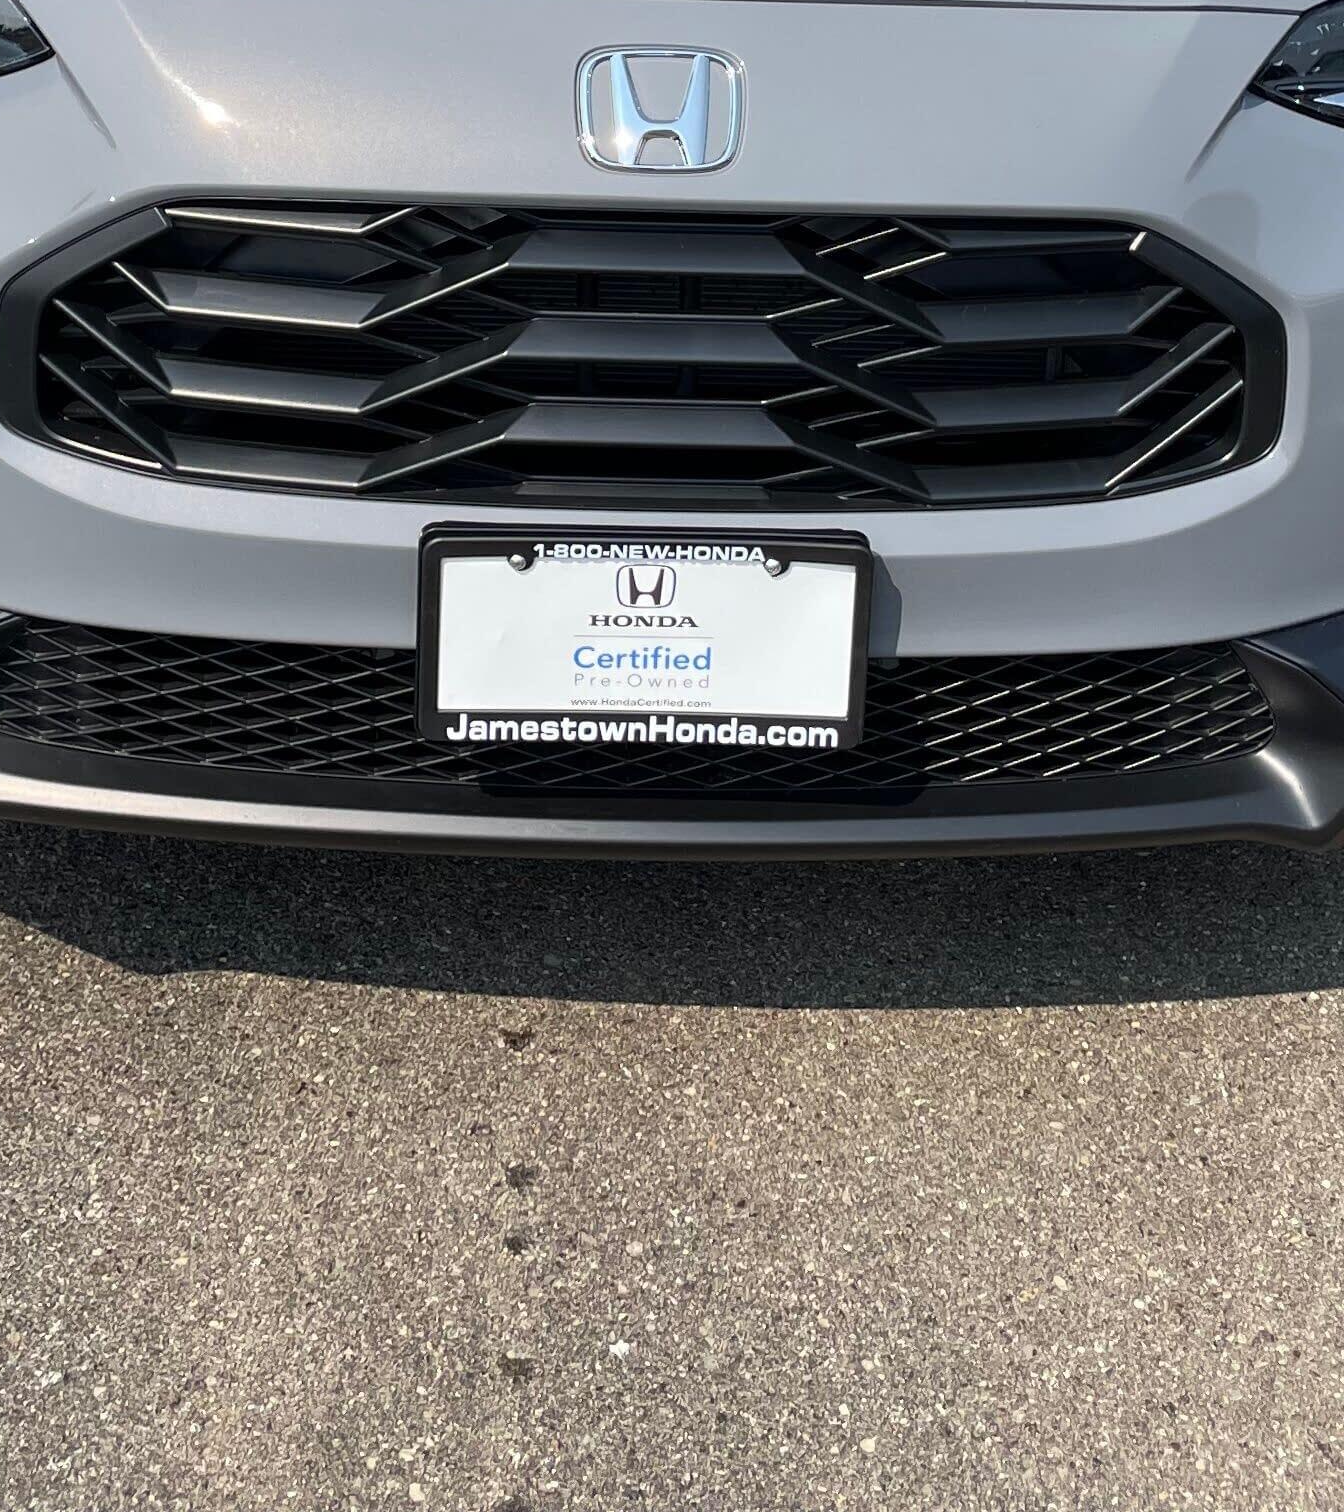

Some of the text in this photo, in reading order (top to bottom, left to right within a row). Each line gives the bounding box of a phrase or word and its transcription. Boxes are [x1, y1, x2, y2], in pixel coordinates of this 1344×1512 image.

[532, 543, 766, 562] 1-800-NEW-HONDA
[588, 615, 699, 628] HONDA
[573, 645, 712, 671] Certified
[573, 673, 710, 689] Pre-Owned
[570, 697, 712, 709] www.HondaCertified.com
[446, 713, 839, 749] JamestownHonda.com
